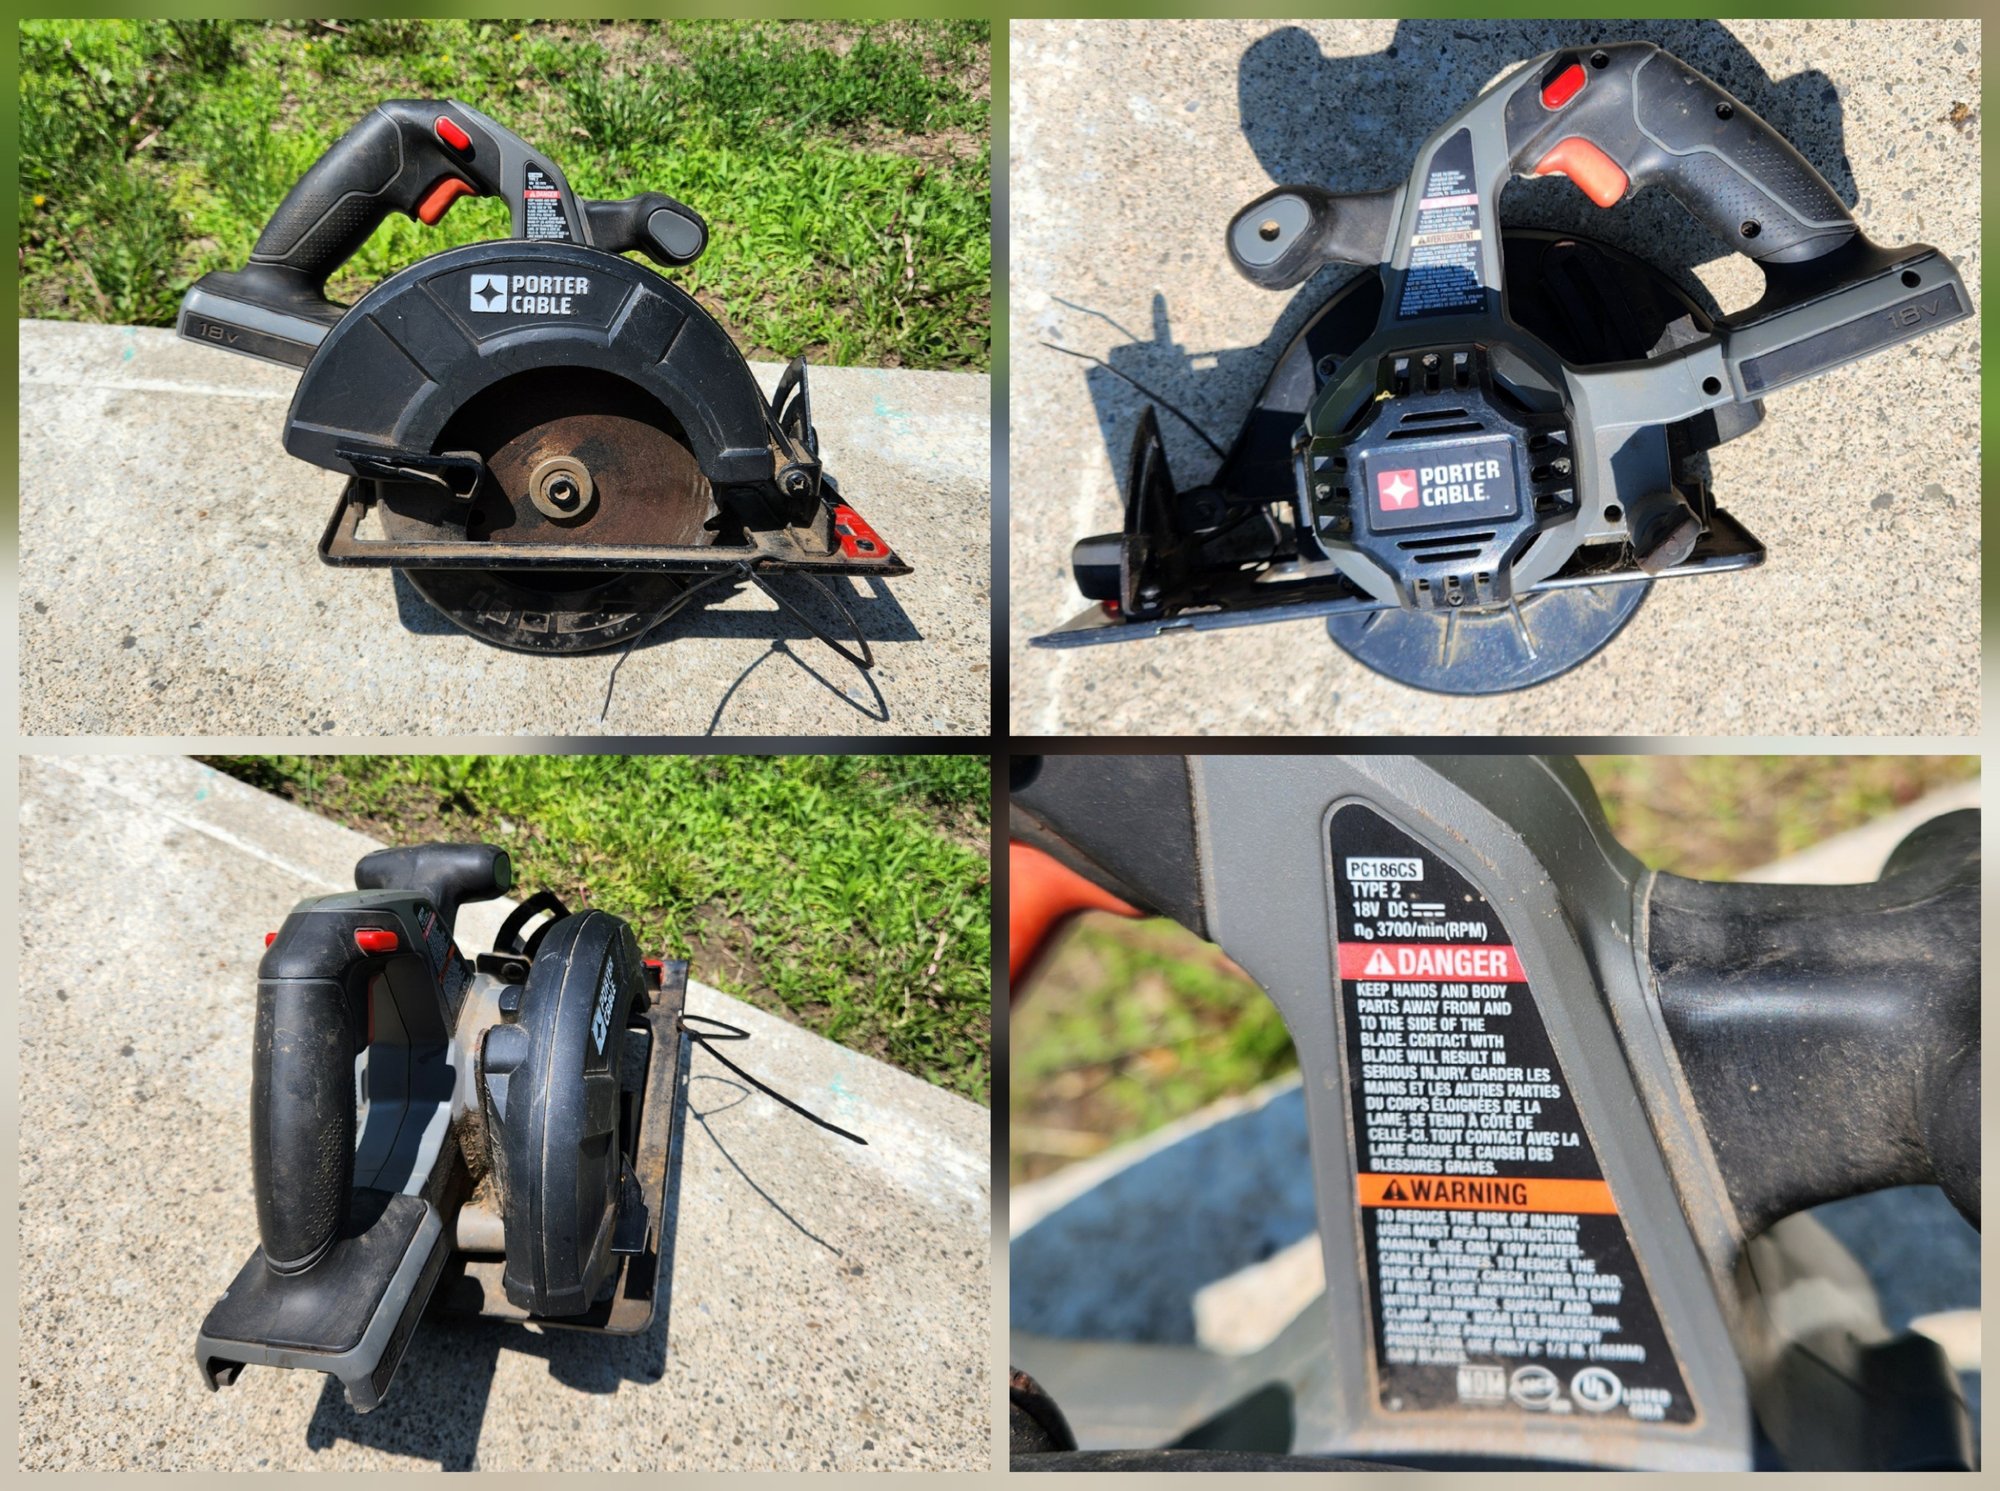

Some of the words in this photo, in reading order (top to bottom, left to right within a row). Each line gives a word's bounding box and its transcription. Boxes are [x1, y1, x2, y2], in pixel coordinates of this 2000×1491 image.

[512, 276, 588, 294] PORTER
[511, 296, 572, 314] CABLE
[1420, 460, 1500, 486] PORTER
[1422, 482, 1485, 507] CABLE
[1351, 862, 1417, 878] PC186CS
[1351, 882, 1388, 898] TYPE
[1392, 882, 1401, 898] 2
[1353, 902, 1380, 917] 18V
[1388, 902, 1408, 918] DC
[1376, 922, 1488, 941] 3700/min(RPM)
[1398, 948, 1508, 976] DANGER
[1356, 983, 1390, 997] KEEP
[1392, 984, 1438, 998] HANDS
[1441, 984, 1468, 998] AND
[1472, 984, 1507, 999] BODY
[1357, 999, 1399, 1014] PARTS
[1402, 1000, 1440, 1014] AWAY
[1442, 1001, 1480, 1014] FROM
[1484, 1001, 1512, 1016] AND
[1359, 1016, 1377, 1030] TO
[1379, 1016, 1404, 1030] THE
[1407, 1017, 1438, 1031] SIDE
[1440, 1018, 1457, 1032] OF
[1460, 1018, 1486, 1032] THE
[1360, 1032, 1406, 1047] BLADE.
[1408, 1033, 1467, 1048] CONTACT
[1470, 1034, 1504, 1048] WITH
[1362, 1048, 1404, 1063] BLADE
[1406, 1050, 1438, 1064] WILL
[1441, 1050, 1488, 1064] RESULT
[1492, 1051, 1506, 1065] IN
[1362, 1064, 1418, 1079] SERIOUS
[1420, 1066, 1468, 1080] INJURY.
[1471, 1067, 1524, 1081] GARDER
[1526, 1068, 1551, 1082] LES
[1364, 1080, 1407, 1095] MAINS
[1409, 1081, 1425, 1096] ET
[1428, 1082, 1452, 1096] LES
[1455, 1082, 1504, 1097] AUTRES
[1507, 1084, 1560, 1098] PARTIES
[1366, 1096, 1384, 1110] DU
[1386, 1097, 1430, 1112] CORPS
[1432, 1095, 1501, 1114] ÉLOIGNÉES
[1504, 1100, 1522, 1114] DE
[1524, 1100, 1542, 1114] LA
[1366, 1112, 1406, 1128] LAME;
[1408, 1113, 1426, 1127] SE
[1428, 1114, 1465, 1128] TENIR
[1480, 1112, 1514, 1129] CÔTÉ
[1516, 1116, 1534, 1130] DE
[1368, 1128, 1428, 1142] CELLE-CI.
[1430, 1129, 1463, 1143] TOUT
[1465, 1130, 1523, 1144] CONTACT
[1526, 1132, 1560, 1146] AVEC
[1562, 1132, 1580, 1146] LA
[1368, 1143, 1406, 1157] LAME
[1407, 1144, 1453, 1158] RISQUE
[1455, 1145, 1473, 1159] DE
[1475, 1146, 1526, 1160] CAUSER
[1528, 1147, 1554, 1162] DES
[1370, 1158, 1443, 1173] BLESSURES
[1445, 1160, 1498, 1175] GRAVES.
[1410, 1179, 1528, 1206] WARNING
[1376, 1208, 1394, 1222] TO
[1396, 1210, 1447, 1224] REDUCE
[1449, 1211, 1475, 1224] THE
[1476, 1212, 1508, 1227] RISK
[1510, 1213, 1528, 1228] OF
[1376, 1224, 1412, 1237] USER
[1412, 1224, 1450, 1238] MUST
[1452, 1226, 1488, 1240] READ
[1490, 1228, 1578, 1244] INSTRUCTION
[1438, 1240, 1464, 1253] USE
[1465, 1240, 1498, 1256] ONLY
[1528, 1243, 1585, 1258] PORTER-
[1378, 1252, 1421, 1266] CABLE
[1496, 1256, 1514, 1270] TO
[1516, 1256, 1568, 1272] REDUCE
[1570, 1259, 1596, 1274] THE
[1380, 1266, 1411, 1280] RISK
[1412, 1266, 1430, 1280] OF
[1482, 1270, 1525, 1284] CHECK
[1526, 1272, 1574, 1286] LOWER
[1380, 1280, 1394, 1293] IT
[1396, 1280, 1433, 1295] MUST
[1434, 1282, 1476, 1296] CLOSE
[1552, 1287, 1588, 1301] HOLD
[1590, 1288, 1622, 1304] SAW
[1382, 1294, 1416, 1308] WITH
[1417, 1295, 1452, 1309] BOTH
[1502, 1299, 1561, 1314] SUPPORT
[1563, 1300, 1593, 1316] AND
[1473, 1312, 1511, 1326] WEAR
[1512, 1313, 1538, 1328] EYE
[1462, 1324, 1514, 1340] PROPER
[1514, 1326, 1603, 1344] RESPIRATORY
[1582, 1376, 1613, 1401] UL
